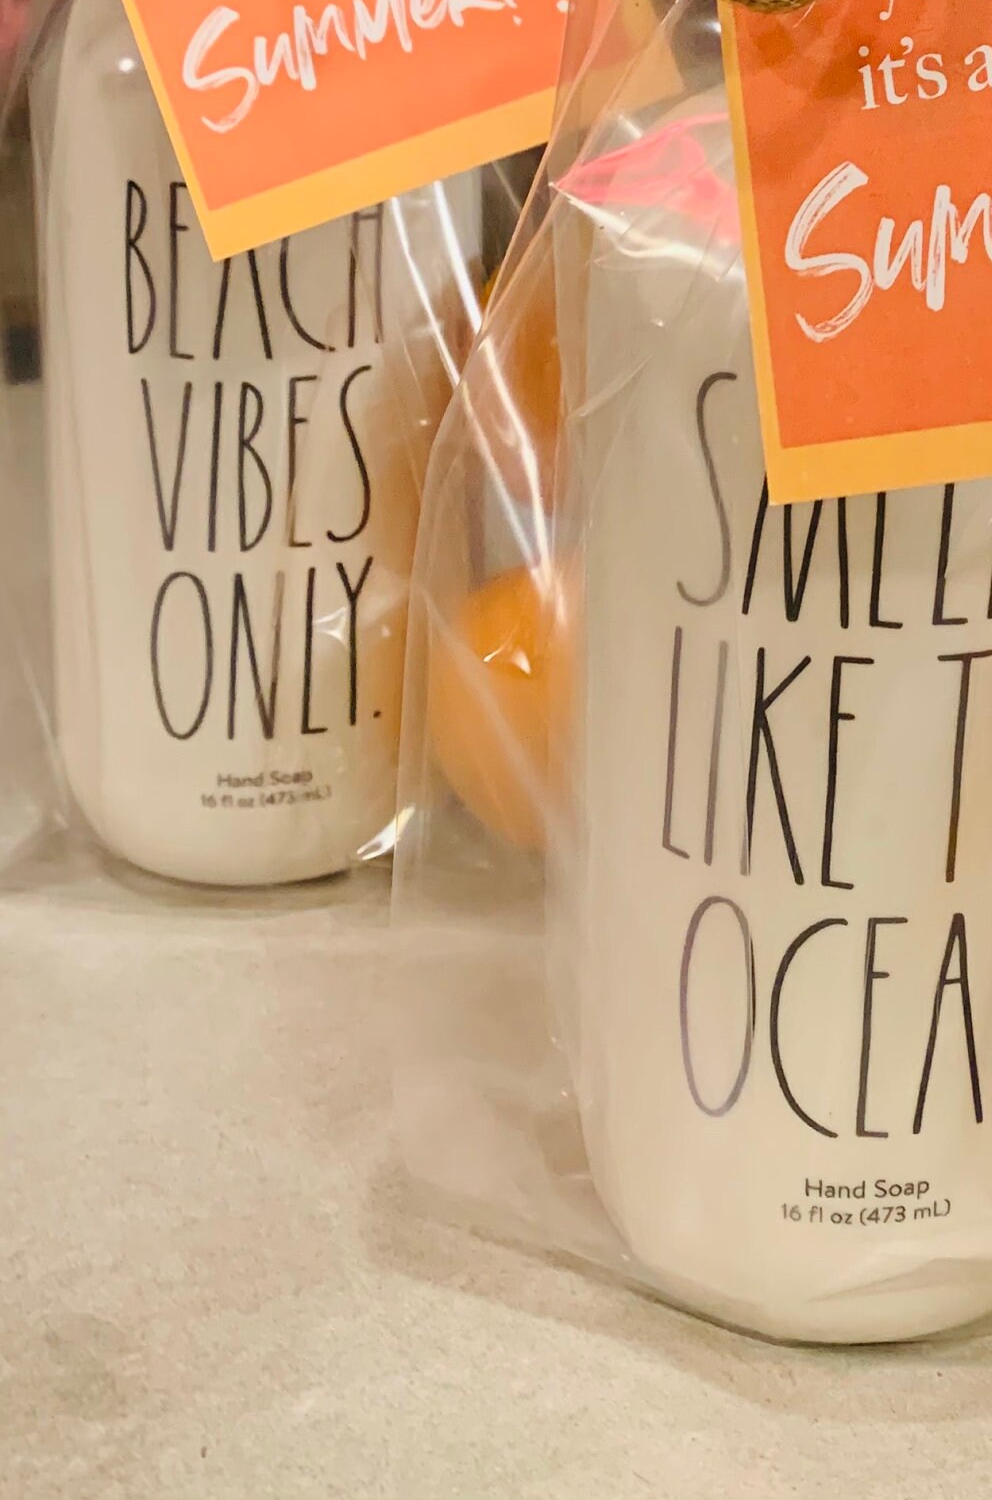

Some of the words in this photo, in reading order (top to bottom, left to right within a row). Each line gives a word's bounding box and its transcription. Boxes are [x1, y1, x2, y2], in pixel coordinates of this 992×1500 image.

[858, 36, 949, 110] it's
[141, 365, 373, 552] VIBES
[150, 556, 383, 741] ONLY.
[217, 770, 264, 788] Hand
[662, 626, 876, 891] LIKE
[781, 1202, 802, 1222] 16
[809, 1205, 824, 1223] fl
[830, 1211, 854, 1225] oz
[860, 1205, 907, 1227] (473
[913, 1198, 952, 1220] mL)
[804, 1177, 866, 1200] Hand
[874, 1179, 930, 1200] Soap
